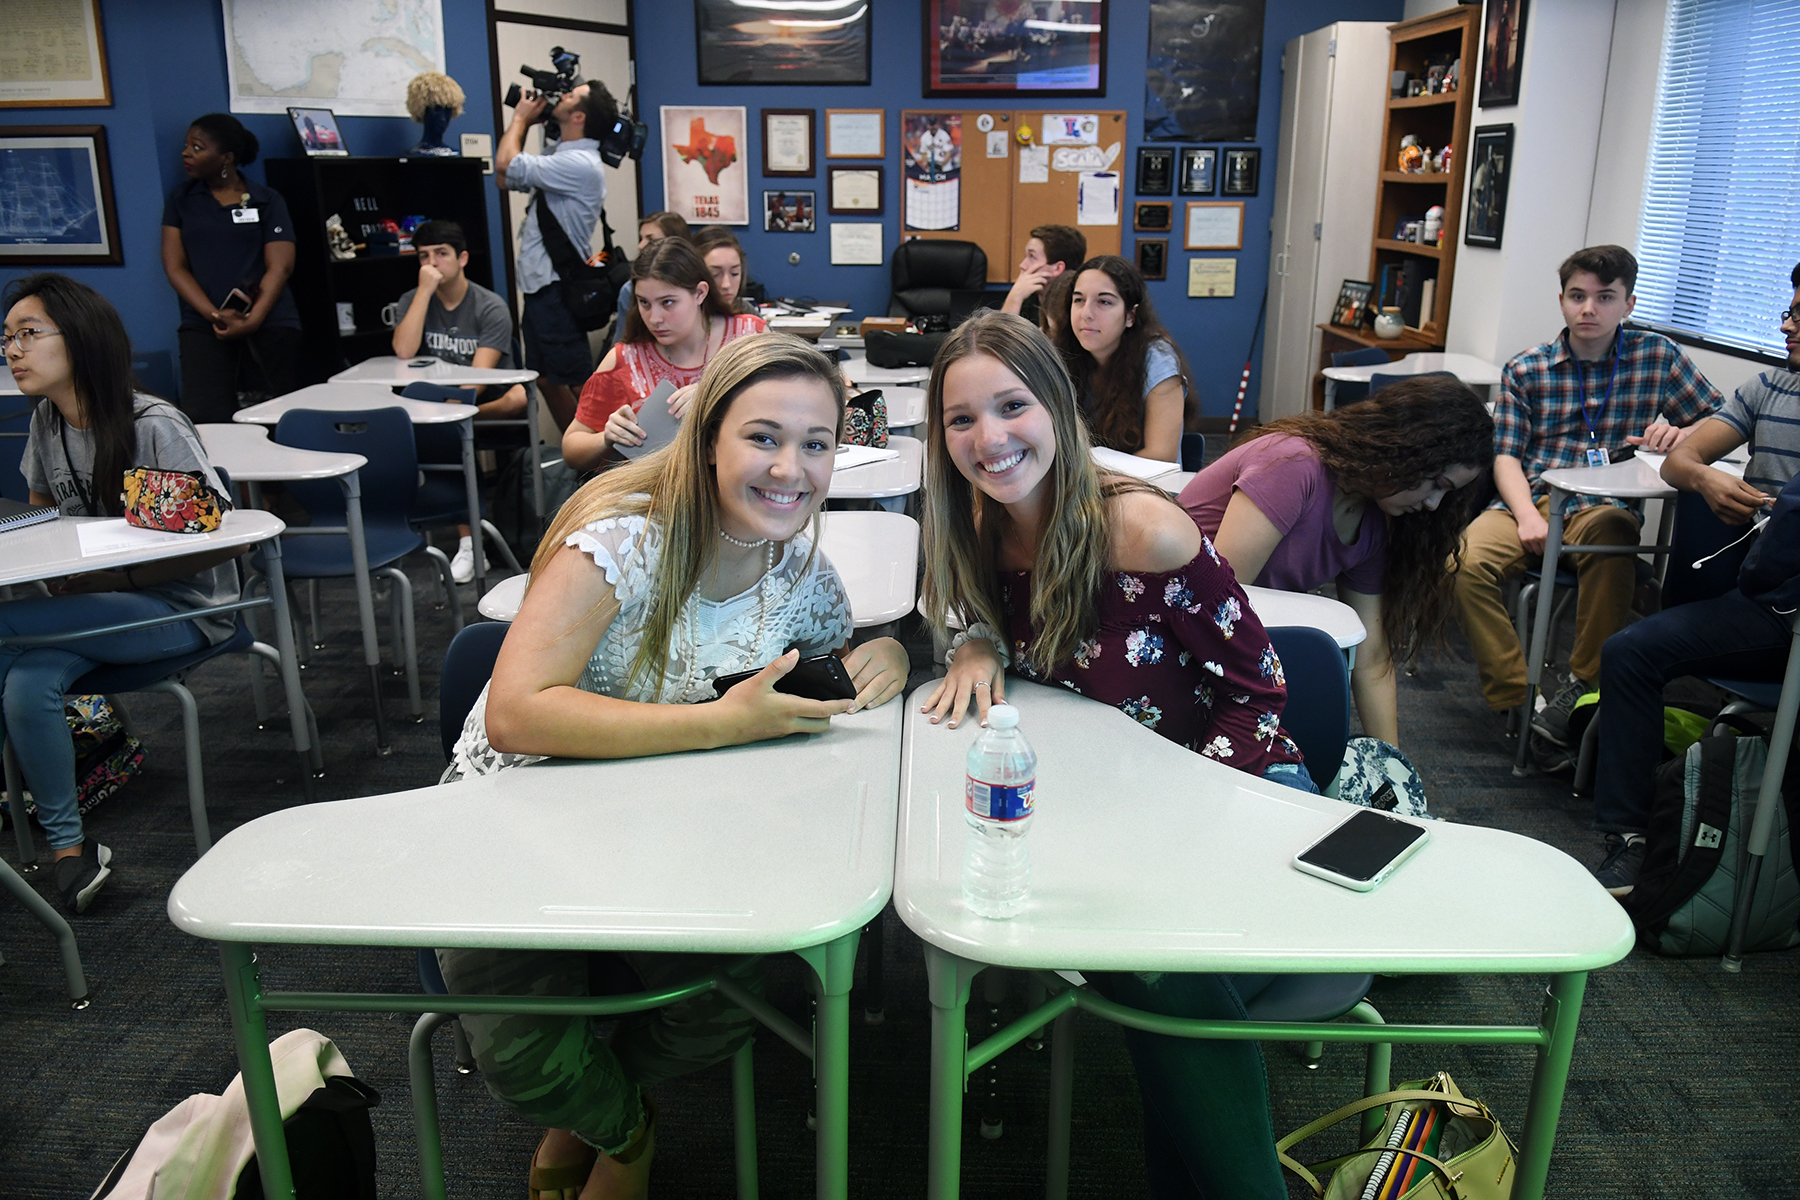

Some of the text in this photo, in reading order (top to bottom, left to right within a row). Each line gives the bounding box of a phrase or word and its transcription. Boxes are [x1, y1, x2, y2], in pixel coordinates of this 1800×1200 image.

[918, 173, 946, 181] MACH
[694, 195, 719, 205] TEXAS
[695, 207, 720, 218] 1845
